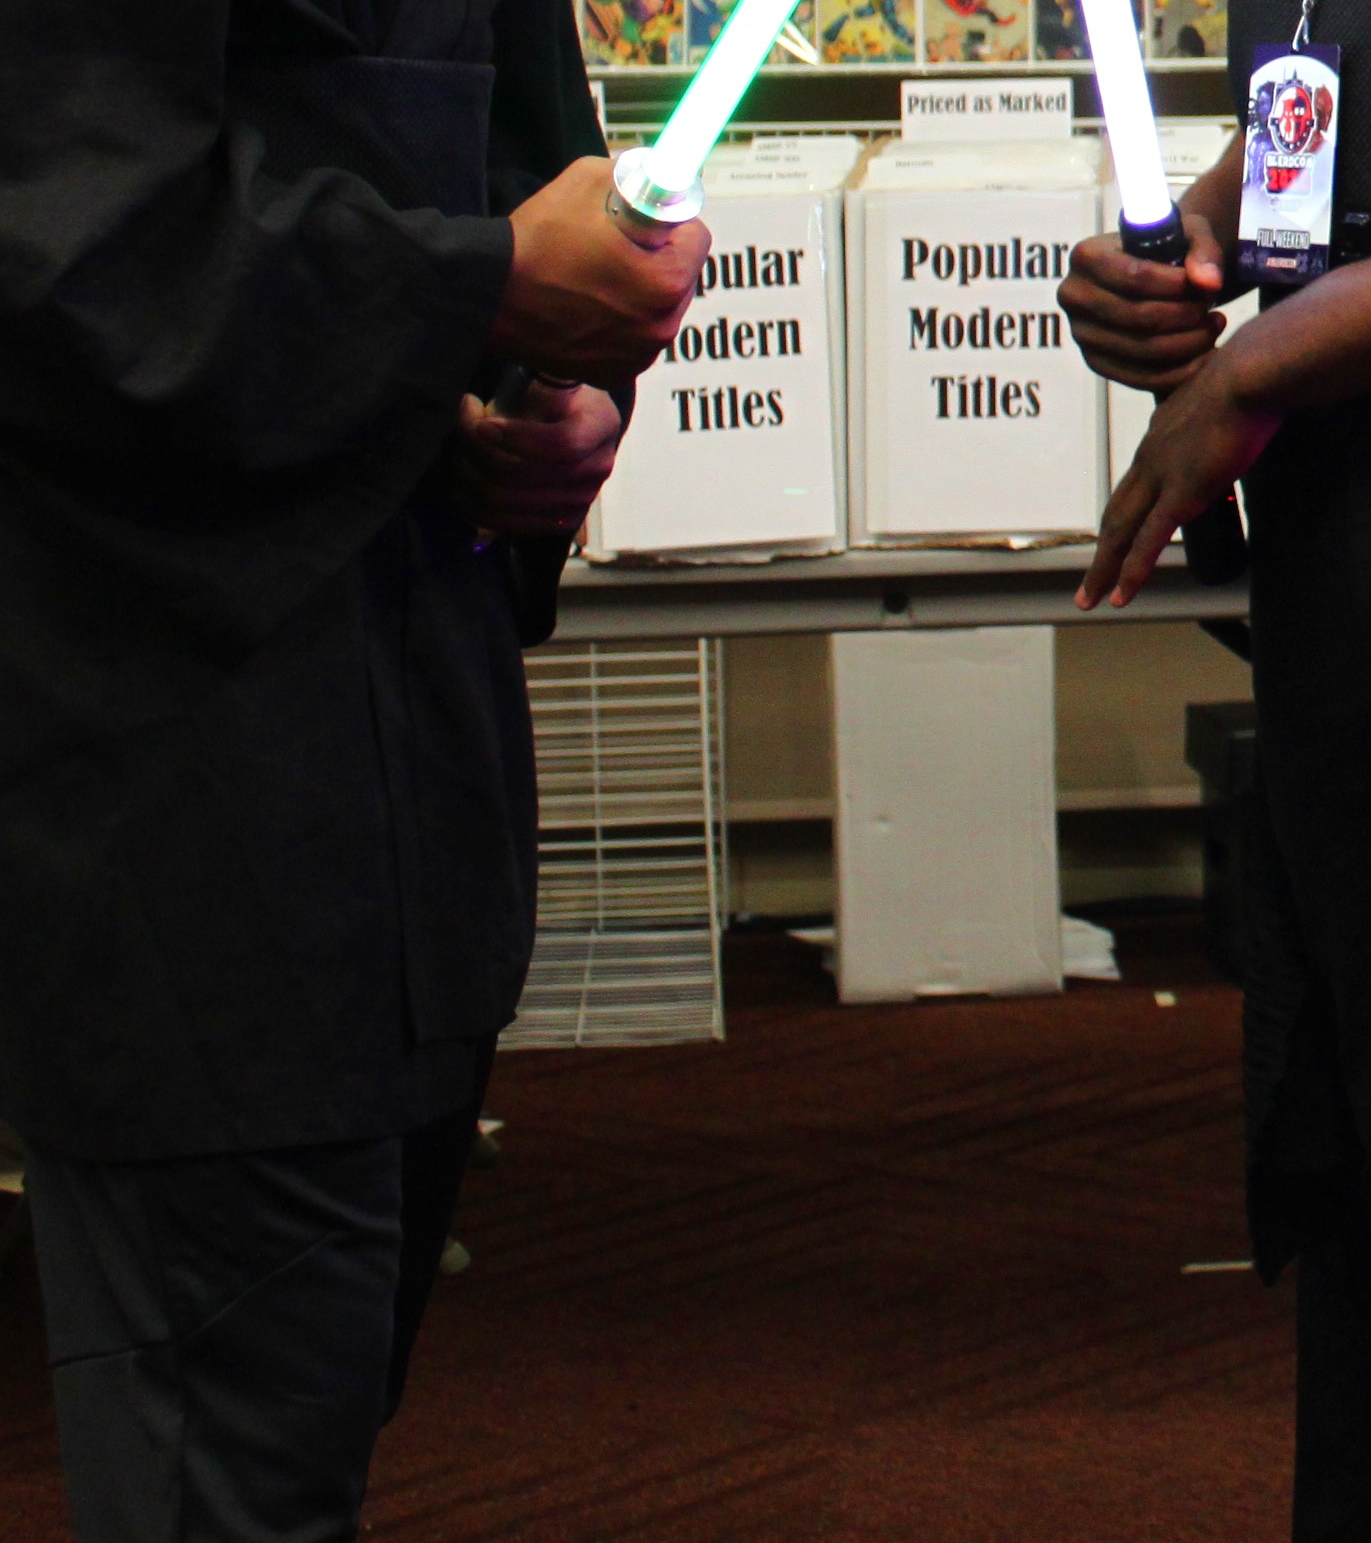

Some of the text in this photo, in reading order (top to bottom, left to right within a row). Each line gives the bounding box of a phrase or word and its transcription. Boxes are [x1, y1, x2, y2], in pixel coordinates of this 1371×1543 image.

[907, 90, 1068, 115] Priced as Marked
[695, 245, 805, 298] pular
[901, 236, 1069, 287] Popular
[663, 316, 803, 363] odern
[908, 306, 1063, 350] Modern
[671, 385, 785, 432] Titles
[930, 373, 1042, 419] Titles
